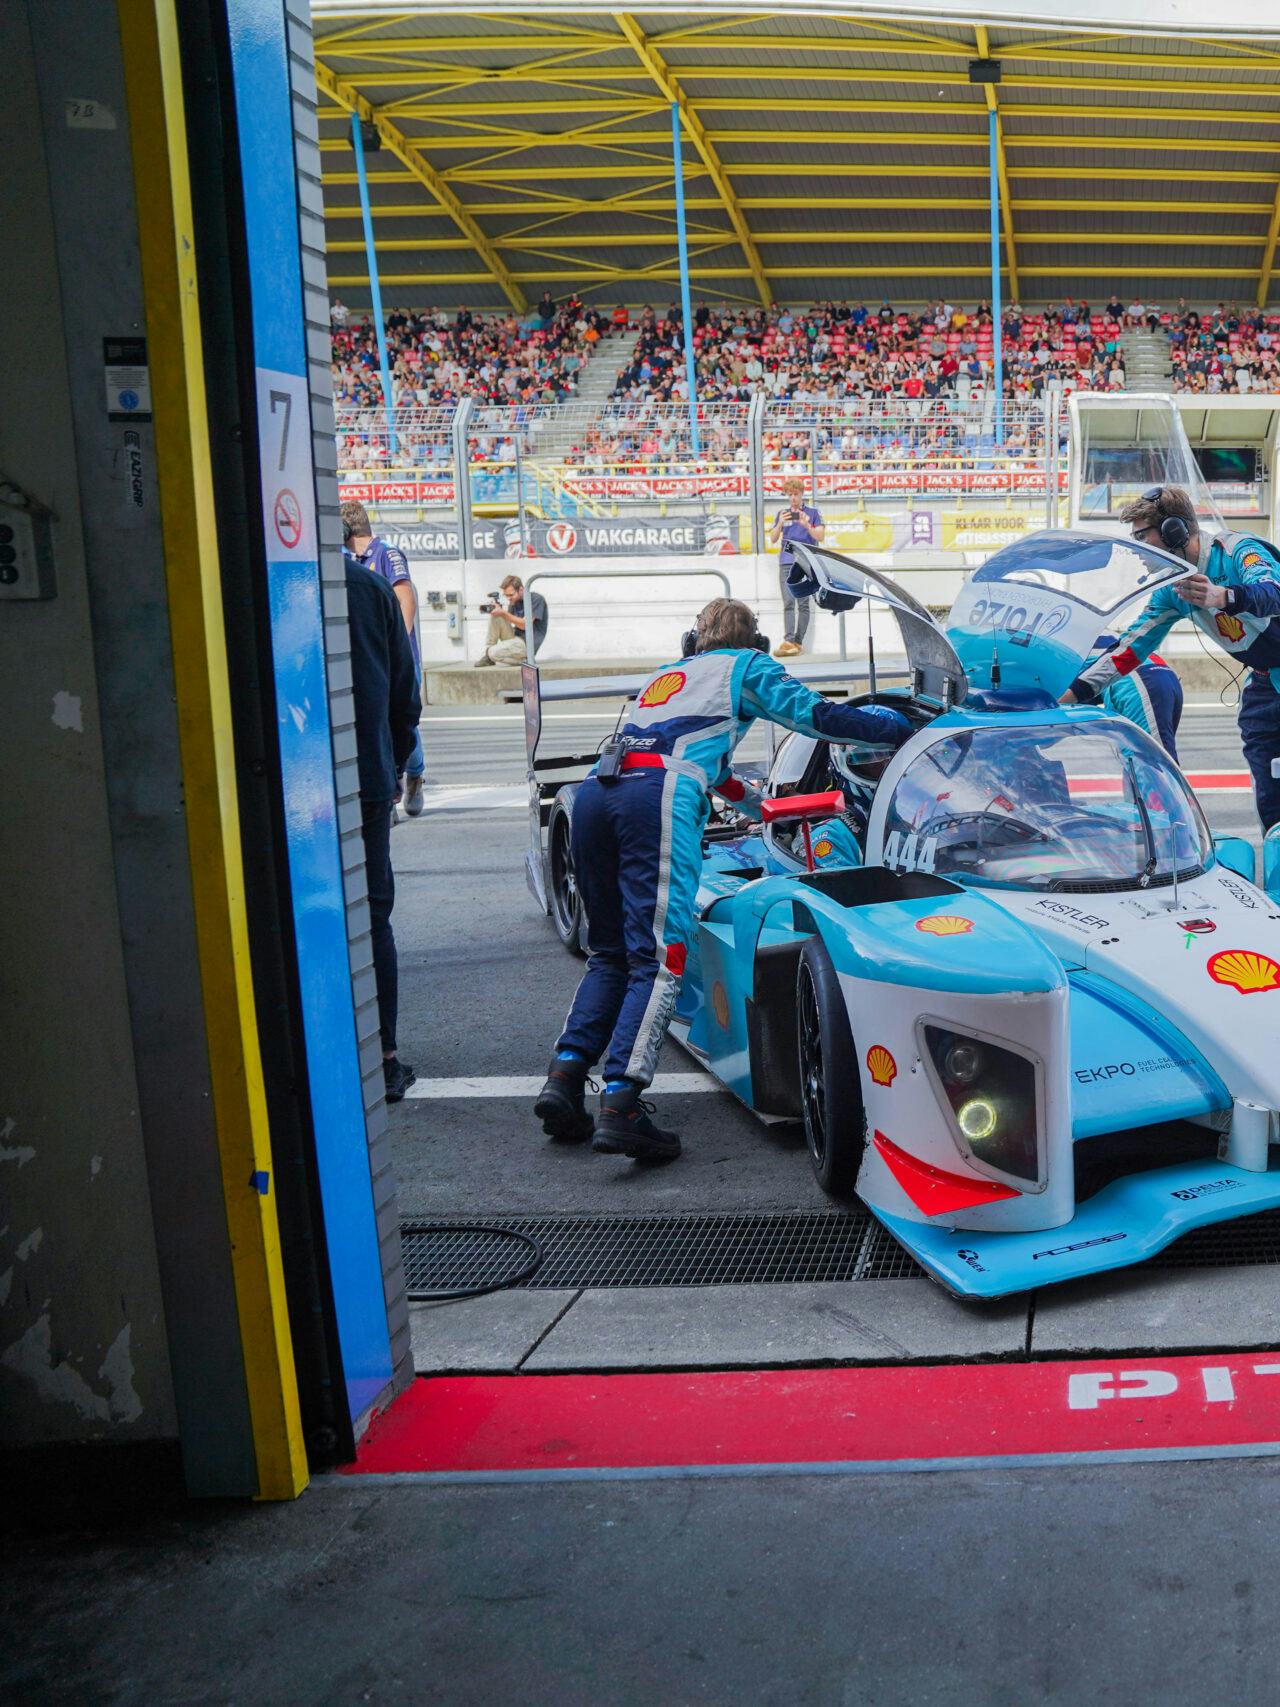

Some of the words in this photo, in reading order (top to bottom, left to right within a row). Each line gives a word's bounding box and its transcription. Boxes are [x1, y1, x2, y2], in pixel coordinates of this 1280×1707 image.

[269, 390, 292, 471] 7
[656, 480, 693, 491] JACK'S
[881, 475, 918, 485] JACK'S
[926, 475, 963, 485] JACK'S
[971, 475, 1008, 485] JACK'S
[339, 487, 369, 497] ACK'S
[956, 518, 991, 530] KLAAR
[995, 518, 1024, 530] VOOR
[386, 532, 496, 551] VAKGARGE
[585, 528, 696, 546] VAKGARAGE
[968, 600, 1044, 648] Forze
[883, 830, 938, 874] 444
[1218, 879, 1260, 910] KISTLER
[1035, 899, 1110, 929] KISTLER
[1074, 1063, 1136, 1084] EKPO
[1187, 1179, 1237, 1193] DELTA
